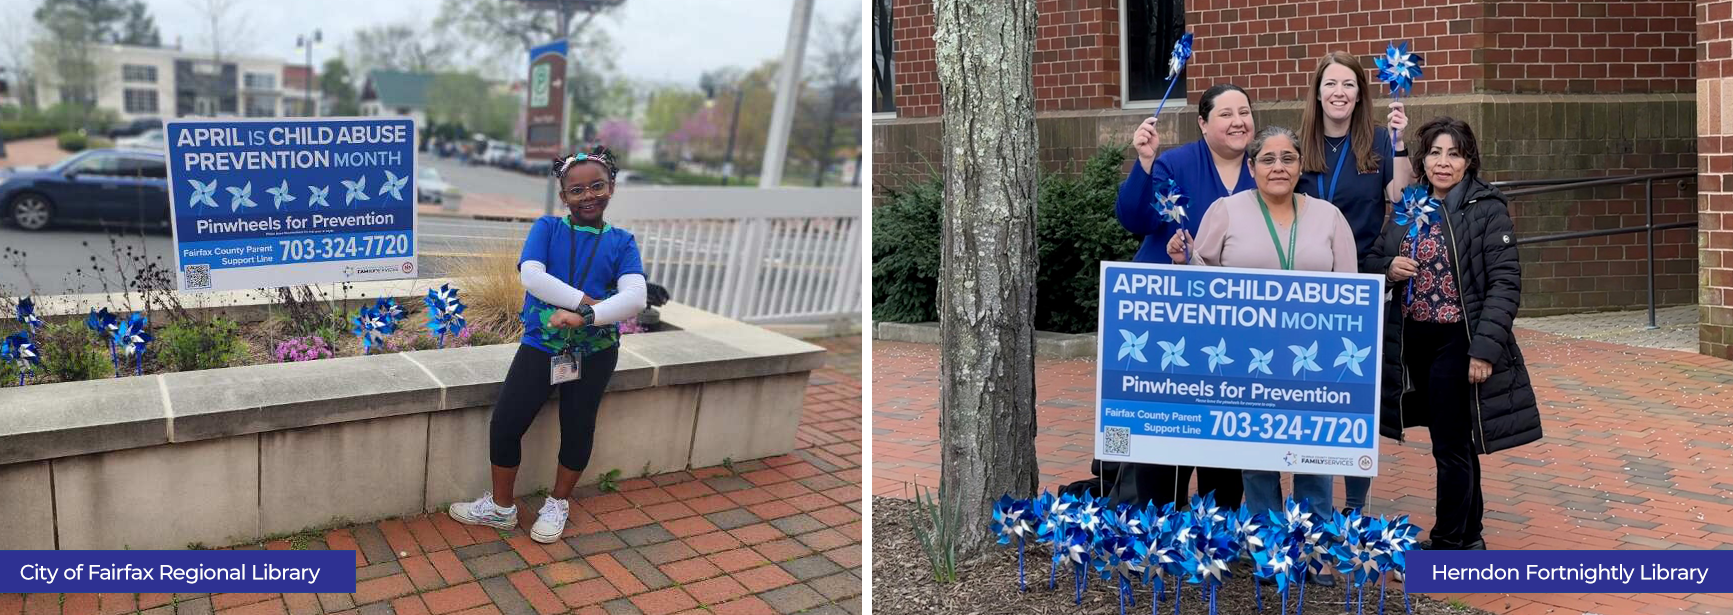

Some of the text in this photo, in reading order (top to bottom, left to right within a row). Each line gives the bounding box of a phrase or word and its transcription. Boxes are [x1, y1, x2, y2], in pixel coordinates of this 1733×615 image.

[177, 125, 406, 147] APRIL IS CHILD ABUSE
[185, 150, 401, 171] PREVENTION MONTH
[196, 217, 281, 234] Pinwheels
[286, 216, 307, 230] for
[312, 212, 394, 228] Prevention
[183, 244, 273, 258] Fairfax County Parent
[279, 234, 408, 261] 703-324-7720
[221, 255, 273, 267] Support Line
[1112, 273, 1370, 305] APRIL IS CHILD ABUSE
[1118, 300, 1363, 332] PREVENTION MONTH
[1122, 375, 1351, 405] Pinwheels for Prevention
[1105, 407, 1202, 423] Fairfax County Parent
[1143, 422, 1202, 435] Support Line
[1209, 410, 1368, 444] 703-324-7720
